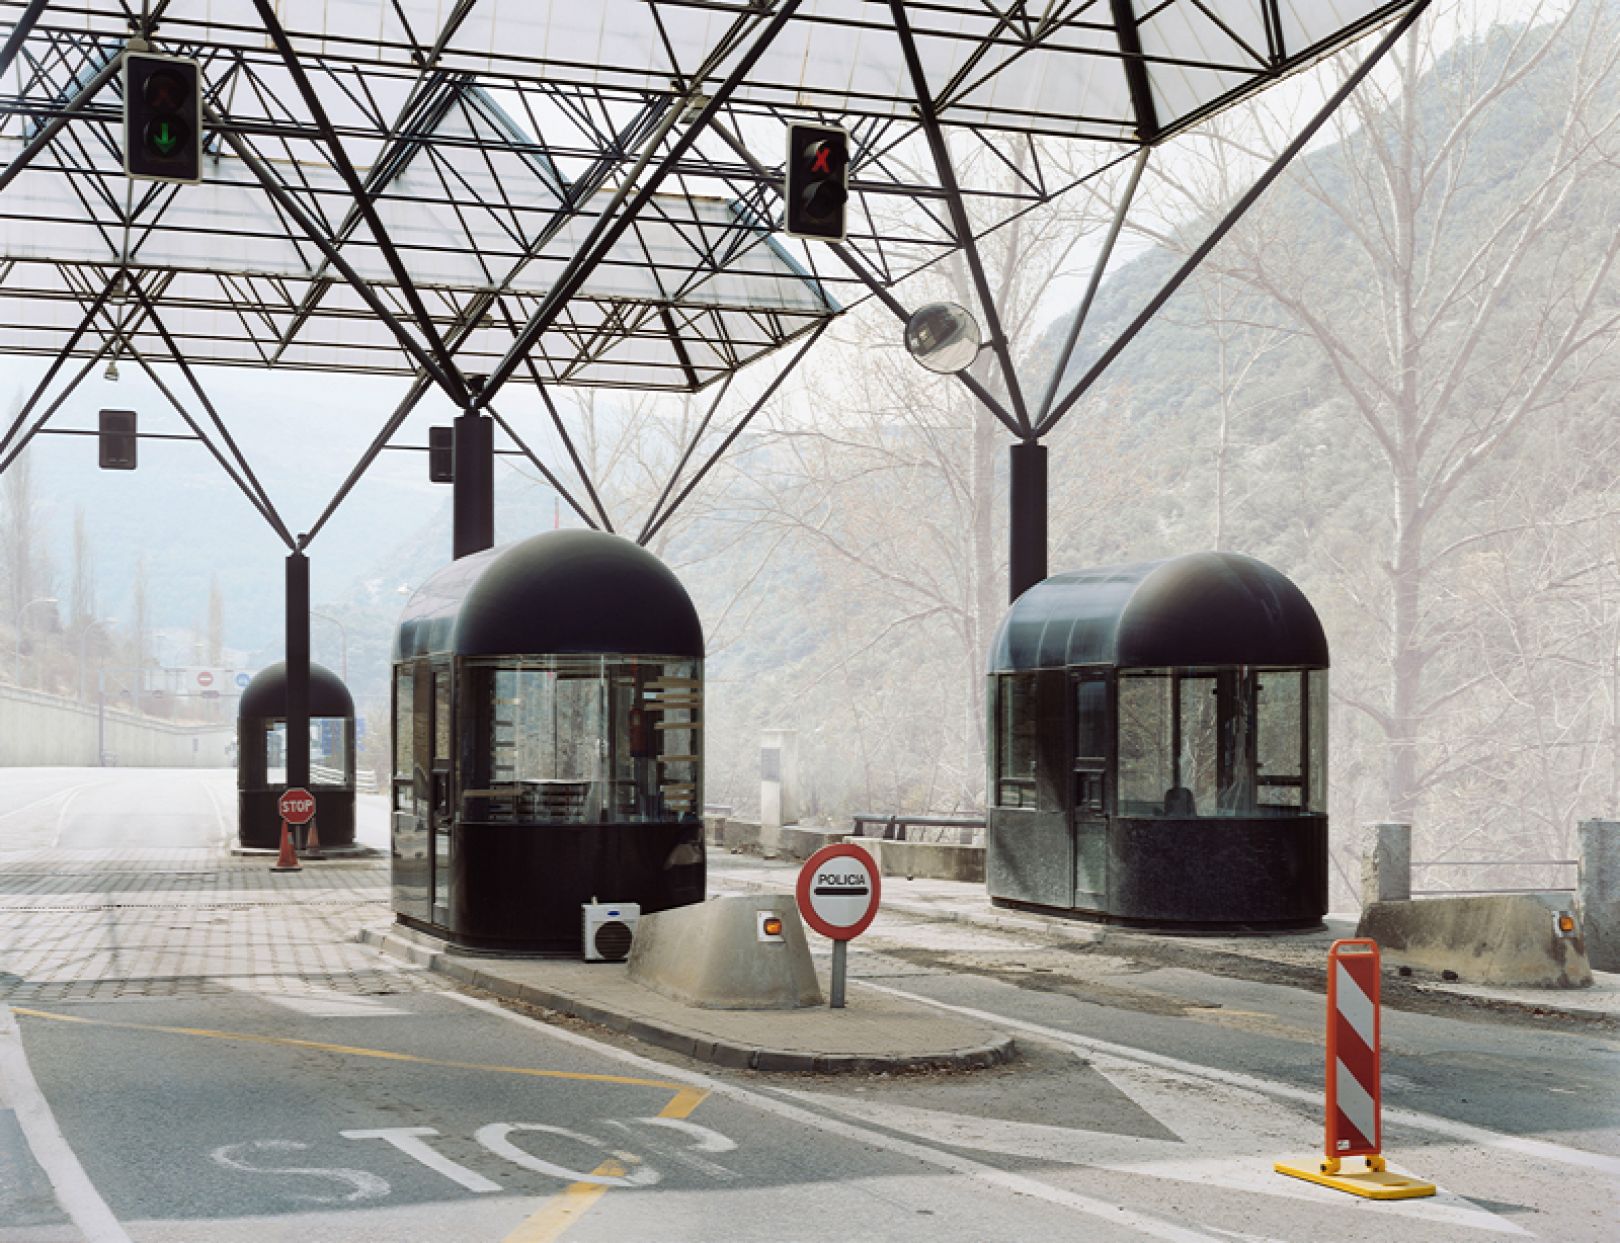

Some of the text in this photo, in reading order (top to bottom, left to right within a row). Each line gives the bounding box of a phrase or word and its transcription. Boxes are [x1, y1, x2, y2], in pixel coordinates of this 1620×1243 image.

[282, 800, 313, 812] STOP
[818, 874, 866, 886] POLICIA
[211, 1117, 742, 1201] STOP
